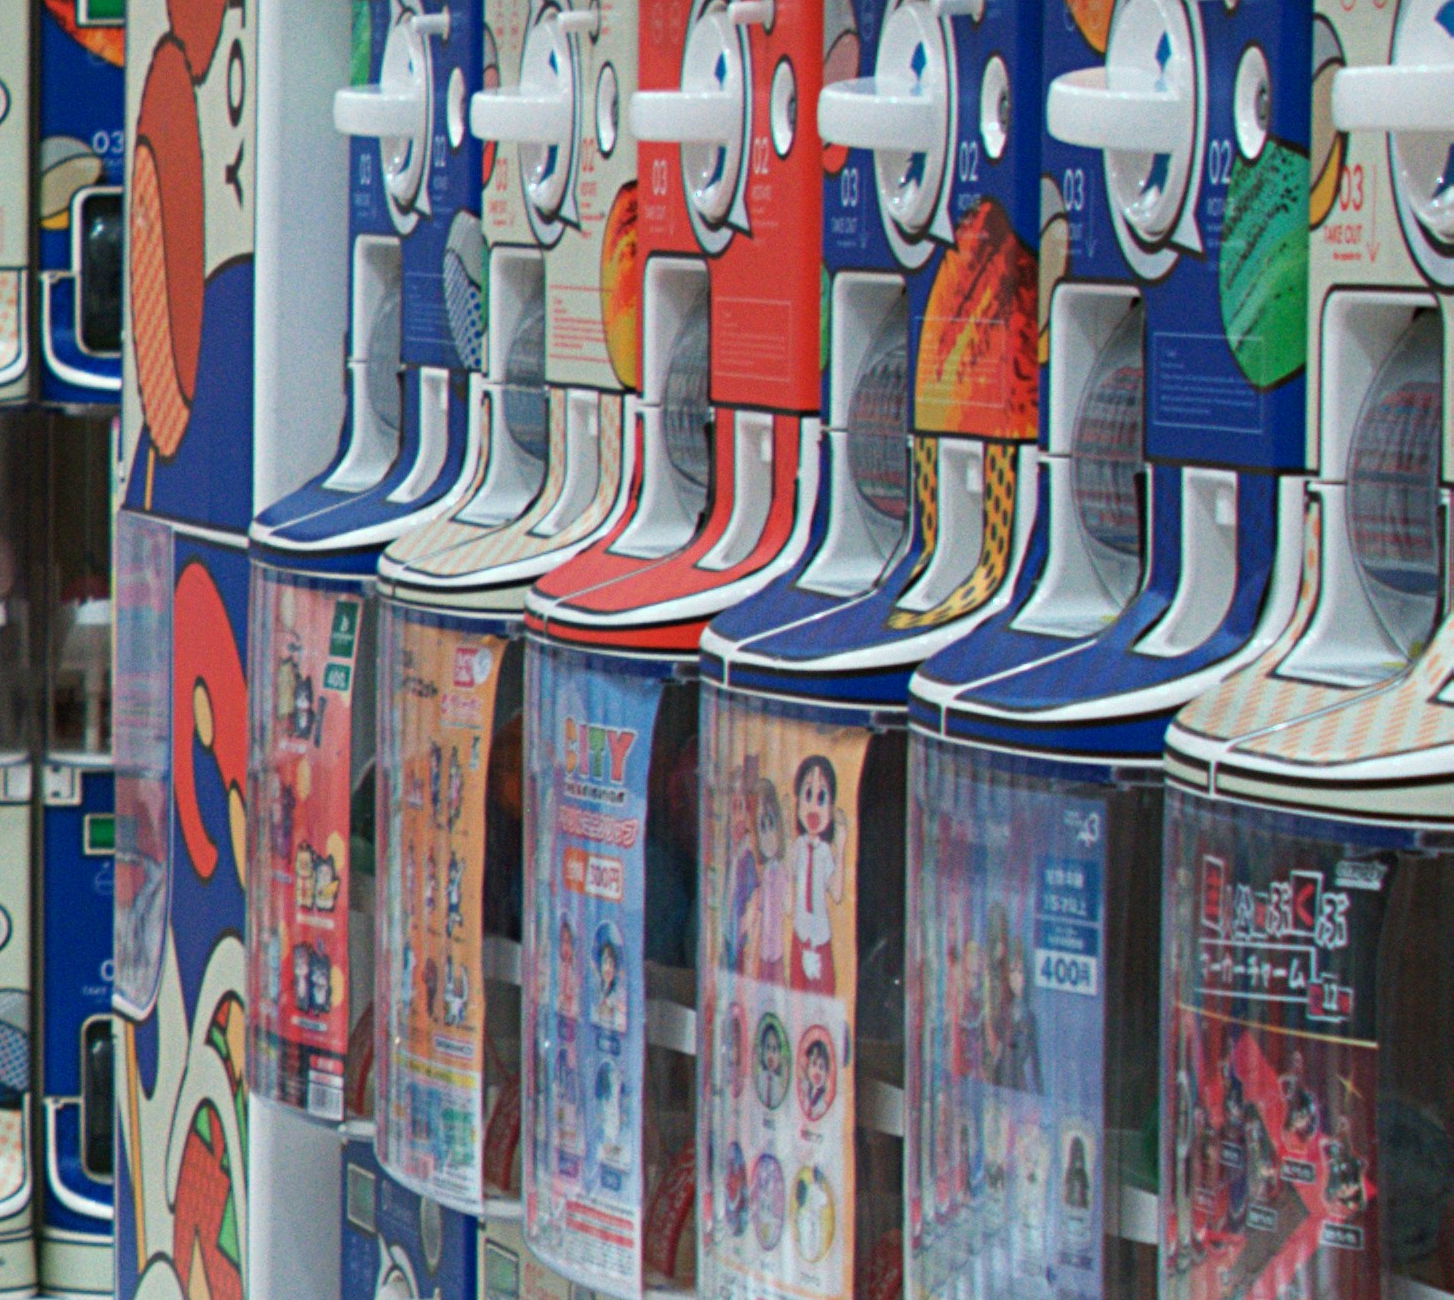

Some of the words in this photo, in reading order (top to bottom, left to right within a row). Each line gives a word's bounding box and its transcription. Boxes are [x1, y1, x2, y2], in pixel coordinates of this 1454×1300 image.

[960, 142, 979, 180] 02
[1209, 141, 1231, 184] 02
[564, 717, 636, 785] CITY
